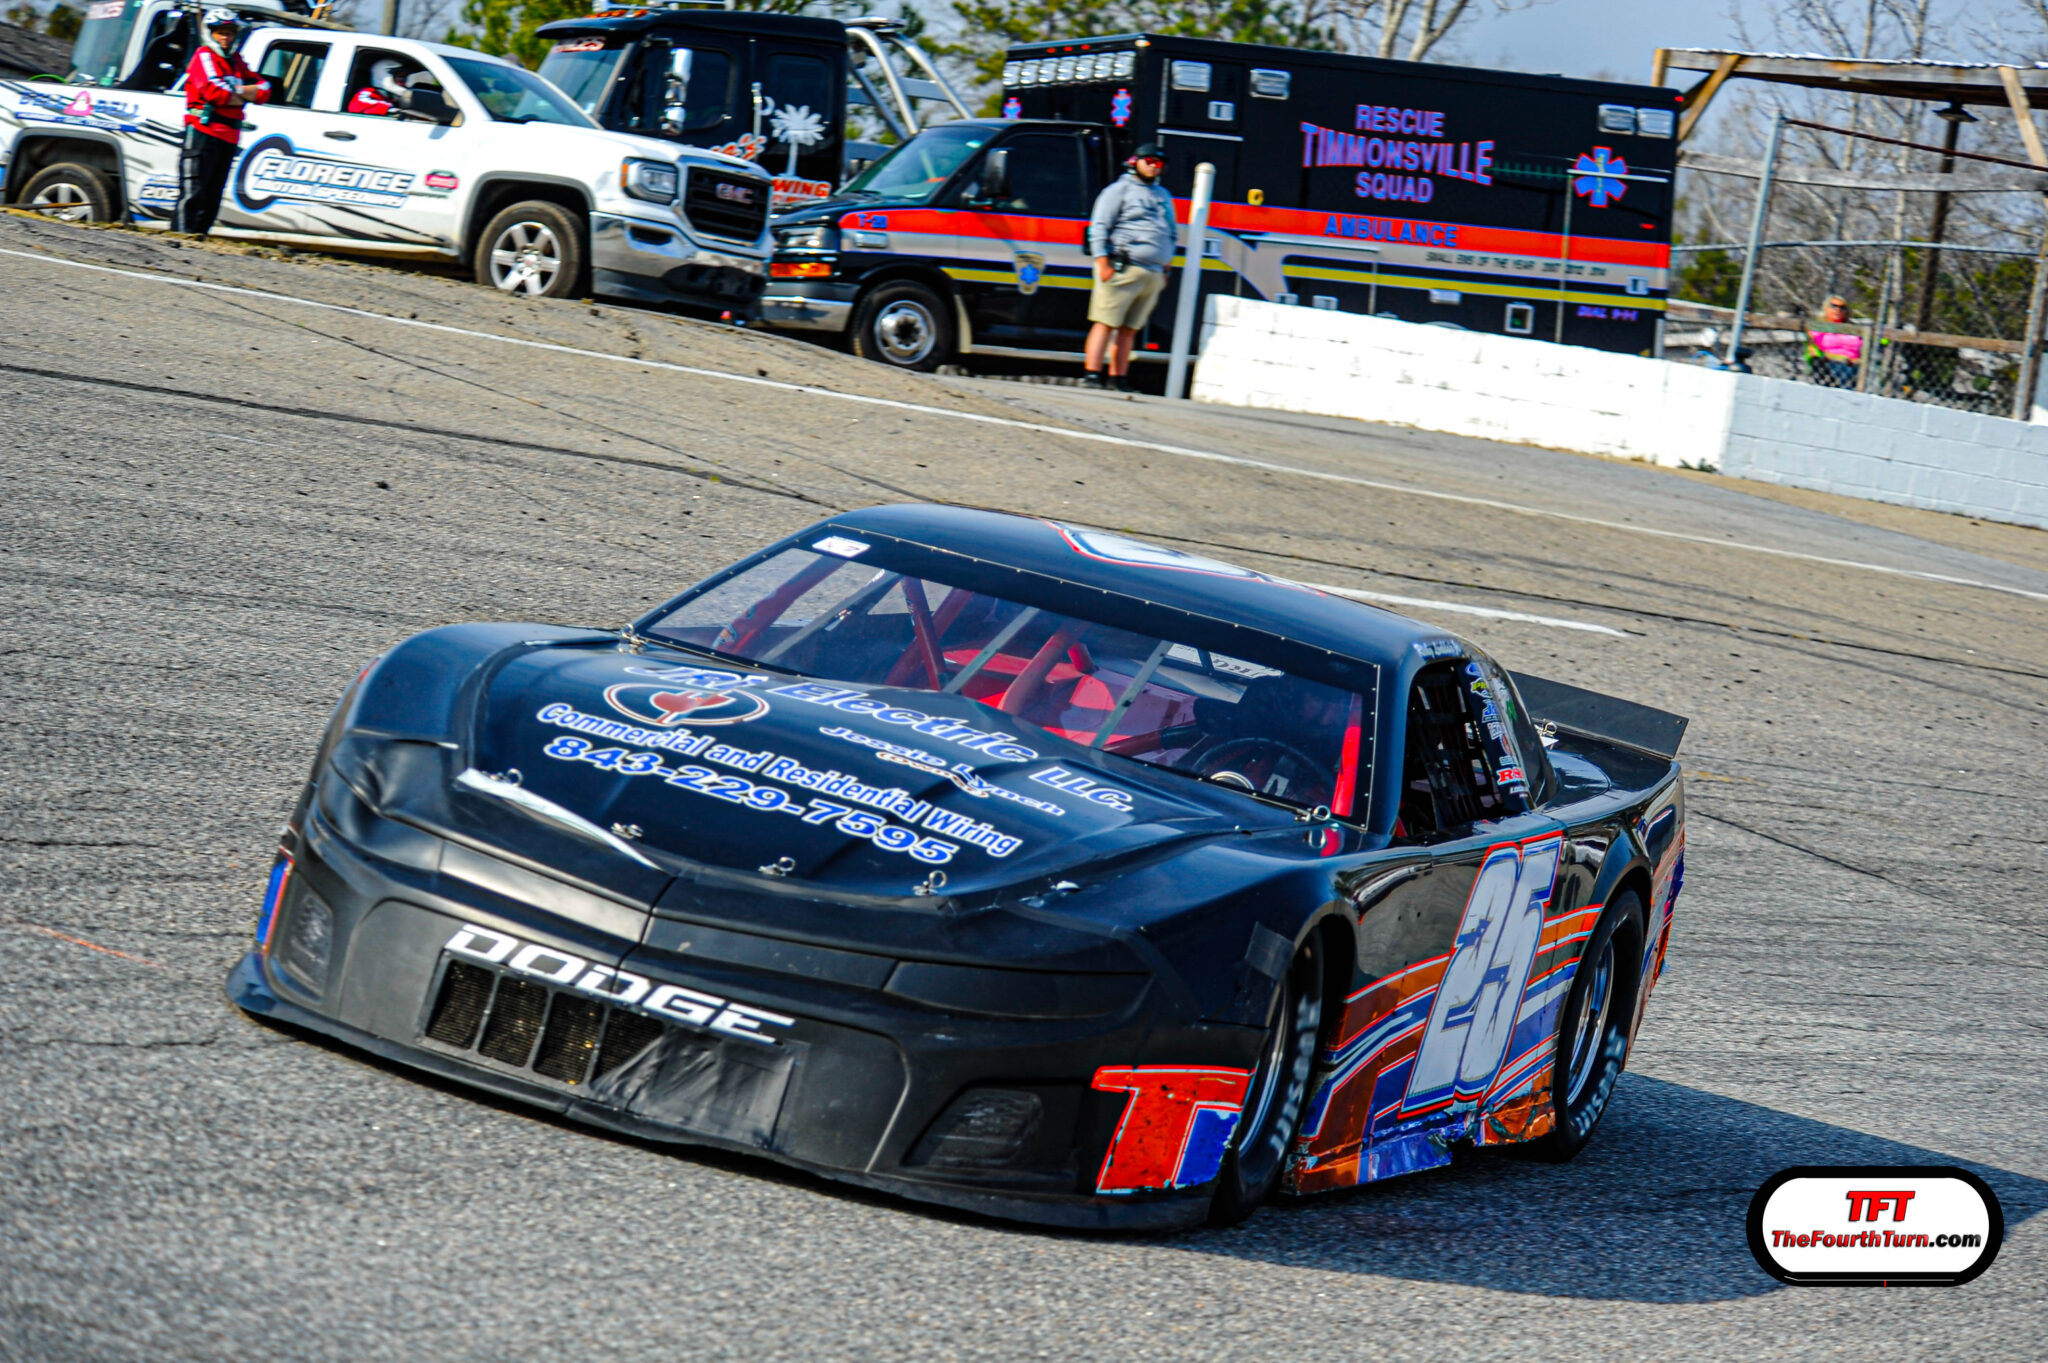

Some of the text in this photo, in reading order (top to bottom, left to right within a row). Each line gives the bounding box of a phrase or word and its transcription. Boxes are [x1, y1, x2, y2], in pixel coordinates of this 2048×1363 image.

[1300, 121, 1495, 186] TIMMONSVILLE
[1356, 104, 1445, 137] RESCUE
[253, 156, 415, 193] FLORENCE
[1355, 171, 1434, 203] SQUAD
[1324, 215, 1458, 247] AMBULANCE
[766, 680, 1039, 764] Electric
[536, 703, 1023, 858] Commercial and Residential Wiring
[543, 736, 960, 864] 843-229-7595
[820, 727, 1066, 816] Jessie Lynch
[445, 923, 796, 1045] DODGE
